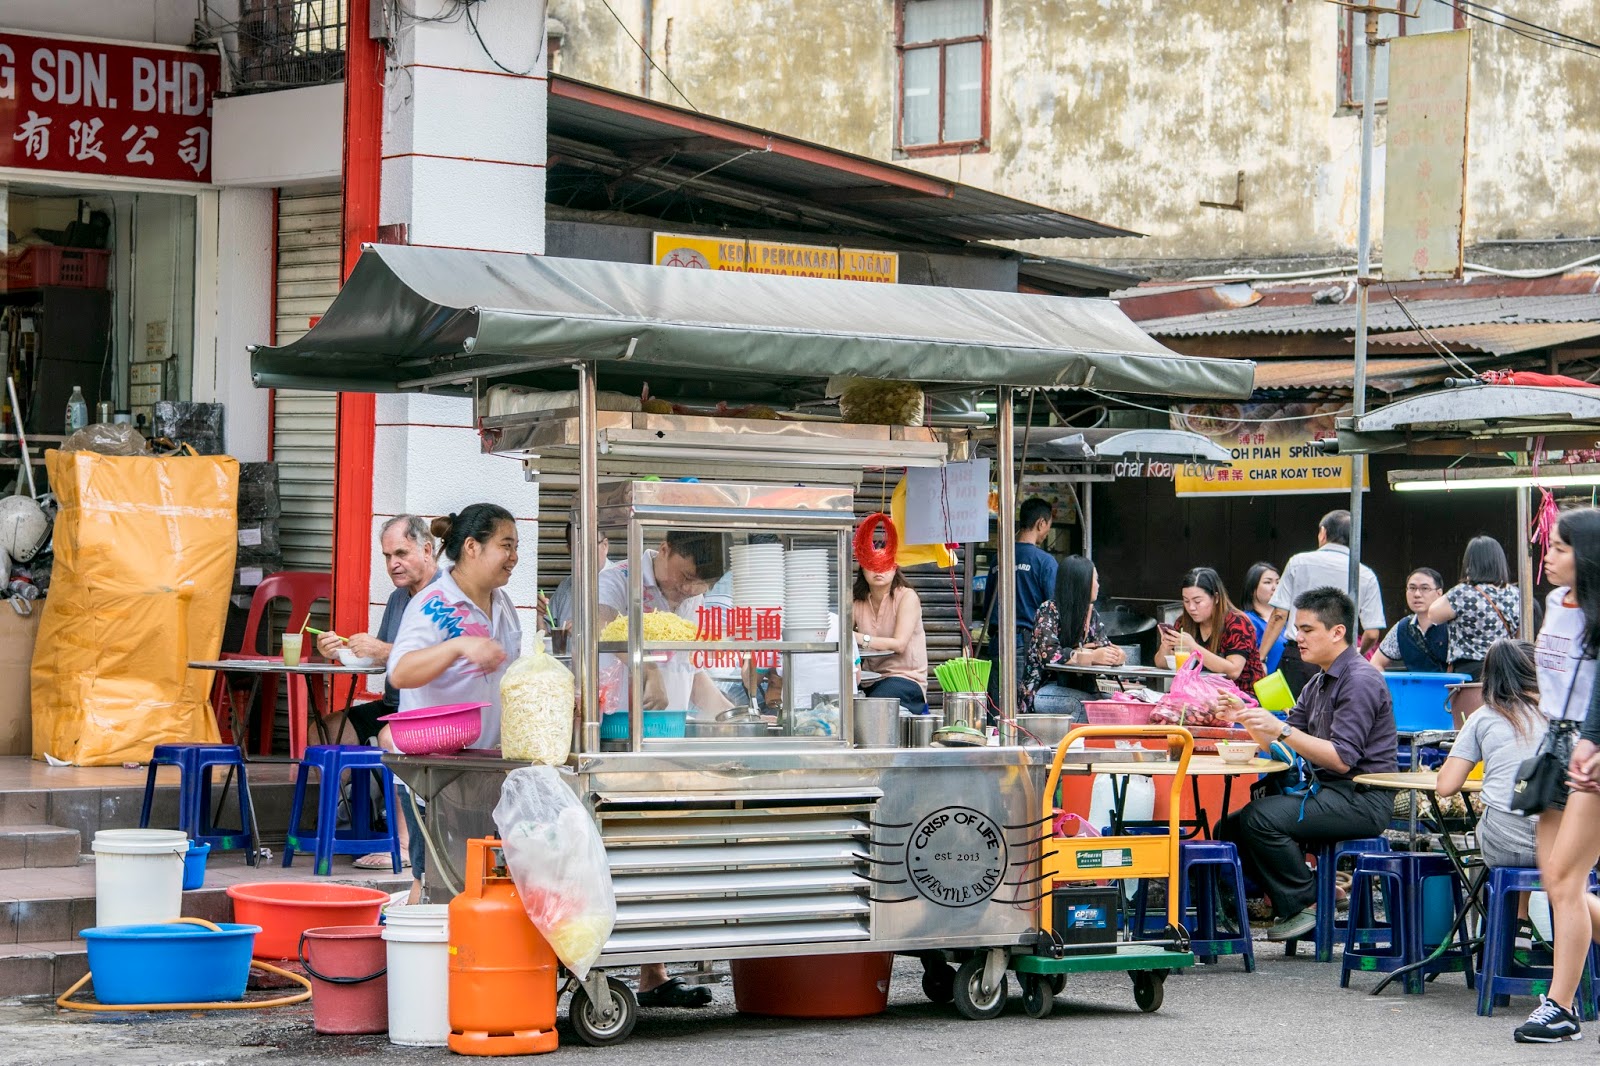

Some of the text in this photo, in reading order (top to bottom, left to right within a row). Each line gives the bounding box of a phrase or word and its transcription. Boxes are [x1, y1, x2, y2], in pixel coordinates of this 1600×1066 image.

[31, 48, 117, 109] SDN.
[132, 57, 212, 118] BHD.
[13, 110, 209, 177] 有限公司
[718, 243, 757, 263] KEDAI
[763, 247, 845, 270] PERKAKASAN
[1228, 446, 1325, 460] OH PIAH SPRIN
[1114, 457, 1143, 477] char
[1147, 458, 1176, 482] koay
[1250, 468, 1279, 480] CHAR
[1281, 468, 1309, 479] KOAY
[1309, 466, 1342, 478] TEOW
[695, 605, 783, 641] 加哩面
[693, 649, 782, 669] CURRY MEE
